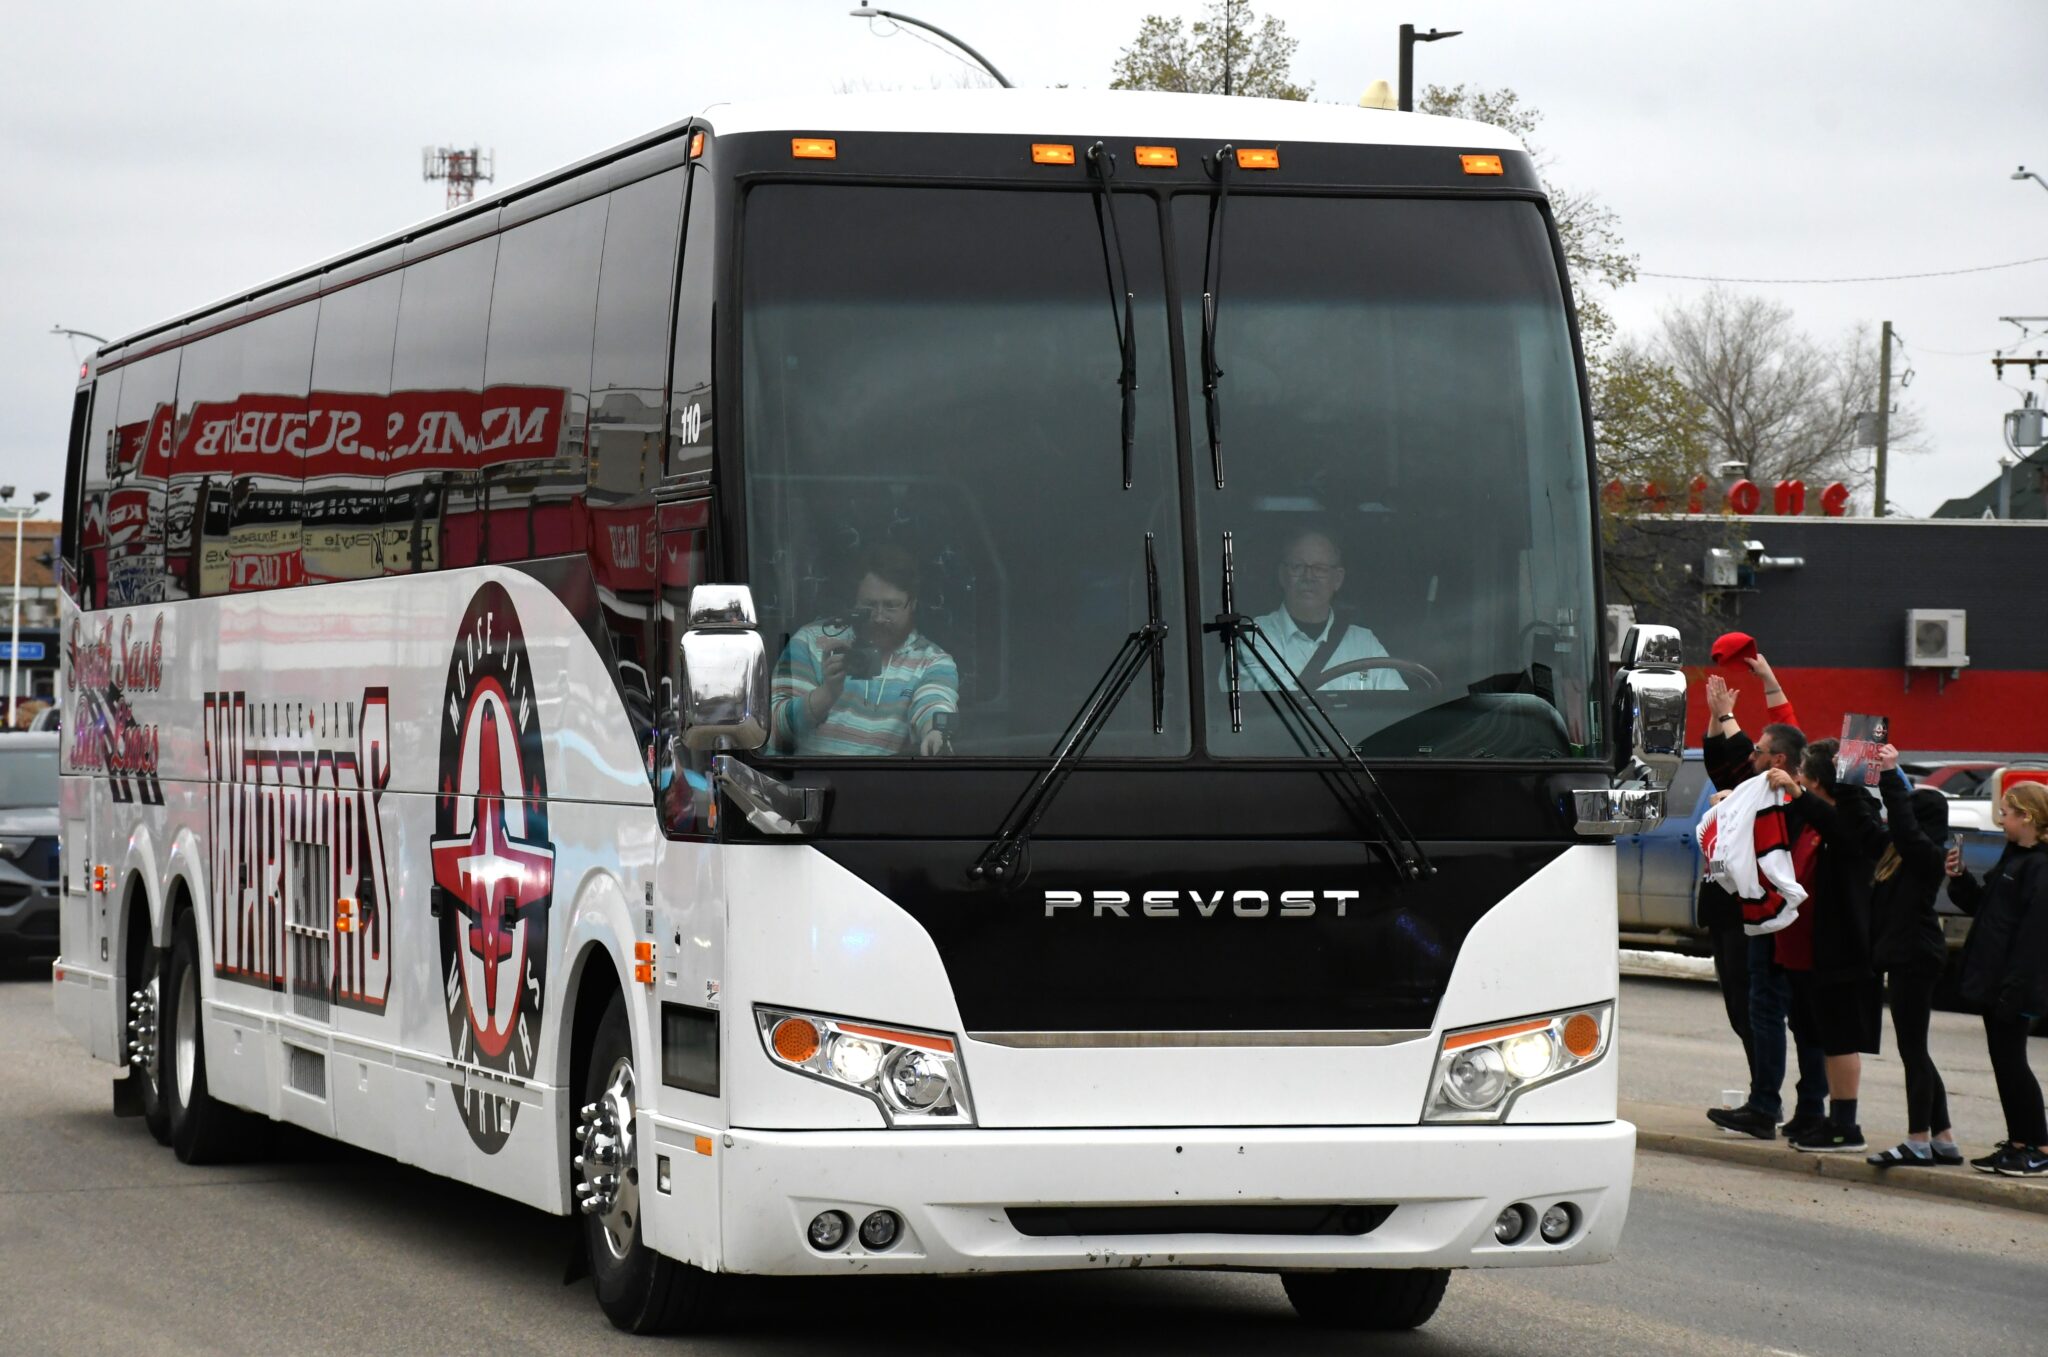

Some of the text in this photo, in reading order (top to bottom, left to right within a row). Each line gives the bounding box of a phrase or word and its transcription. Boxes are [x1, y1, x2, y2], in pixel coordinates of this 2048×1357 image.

[681, 402, 701, 445] 110
[450, 612, 530, 735] MOOSE JAW
[248, 701, 354, 738] MOOSE JAW
[1044, 890, 1360, 917] PREVOST
